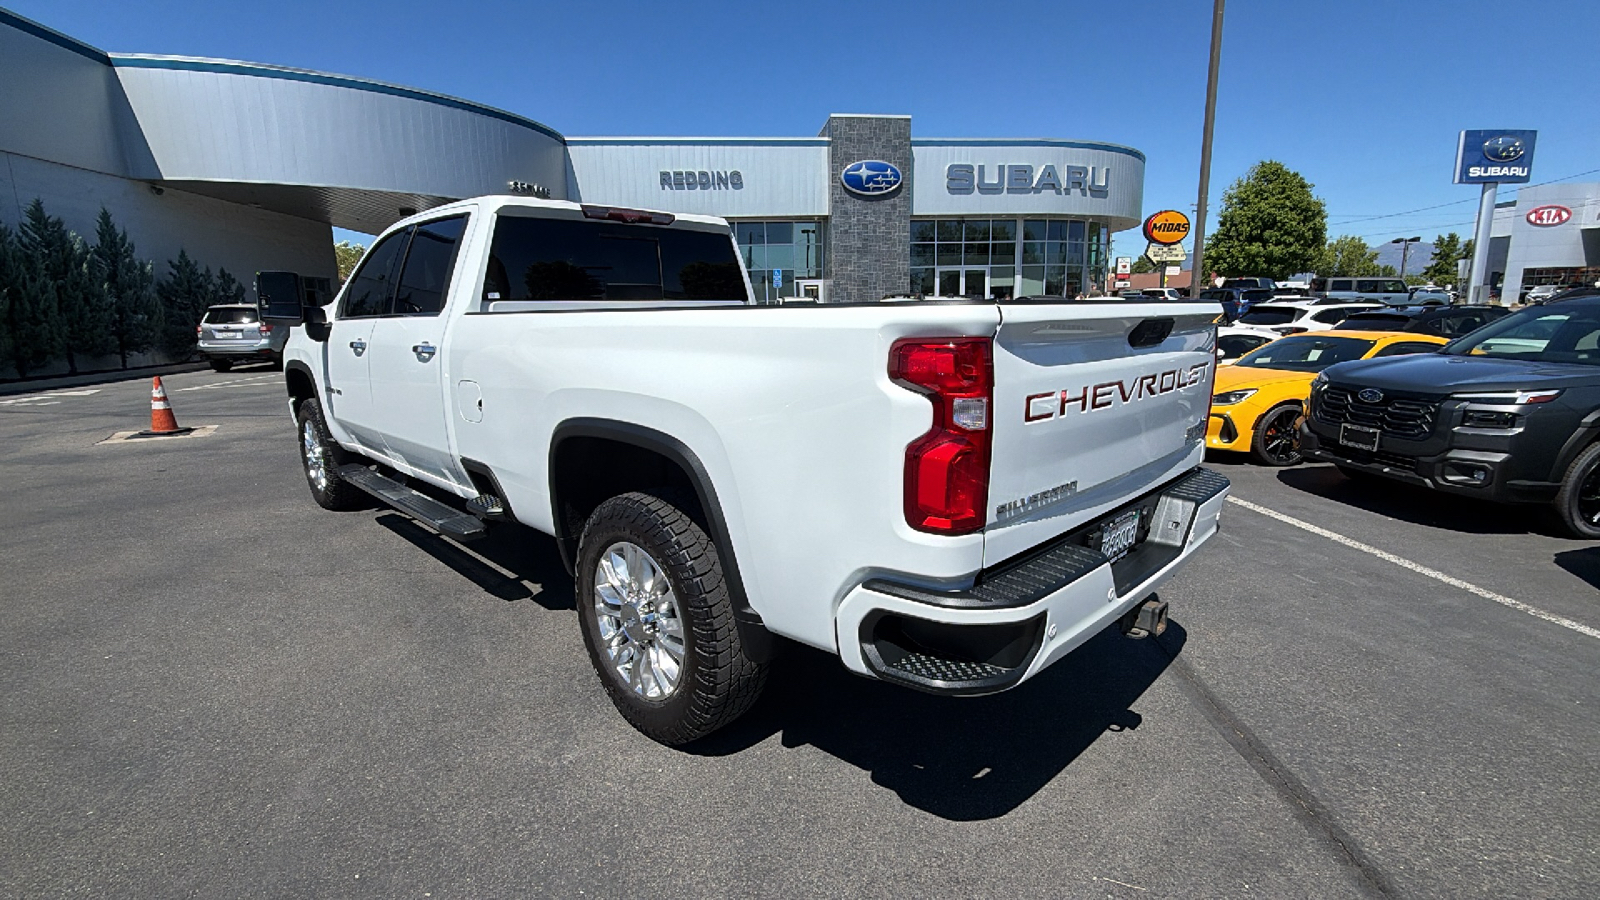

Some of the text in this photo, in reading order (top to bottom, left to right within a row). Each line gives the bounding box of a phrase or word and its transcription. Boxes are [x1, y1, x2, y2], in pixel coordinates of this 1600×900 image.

[659, 170, 744, 191] REDDING
[1468, 166, 1528, 177] SUBARU
[946, 163, 1110, 199] SUBARU
[1533, 208, 1565, 224] KIA
[1151, 222, 1189, 233] MIDAS
[1024, 362, 1210, 424] CHEVROLET
